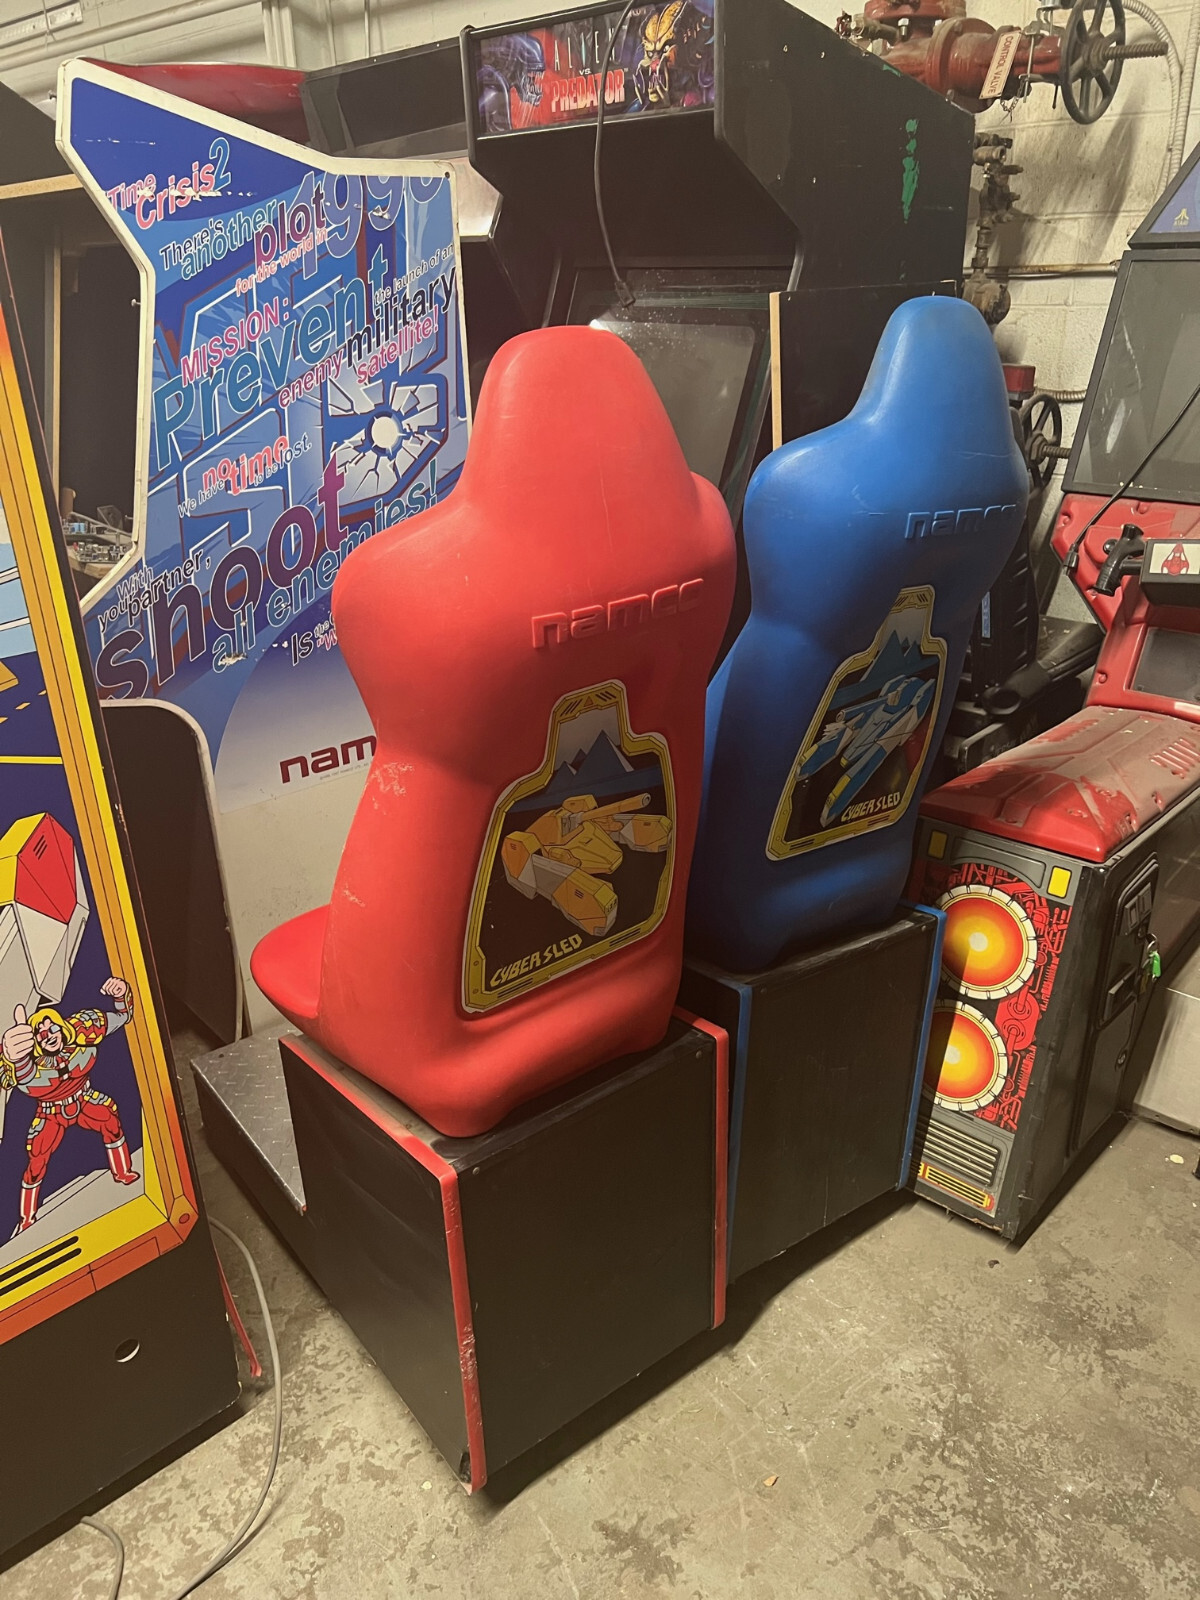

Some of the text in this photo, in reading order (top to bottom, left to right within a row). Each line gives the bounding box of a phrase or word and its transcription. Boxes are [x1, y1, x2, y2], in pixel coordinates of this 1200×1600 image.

[554, 28, 615, 72] ALIEN
[988, 36, 1014, 94] CONTROL VALVE
[551, 69, 626, 113] PREDATOR
[106, 174, 156, 211] Time
[136, 161, 216, 230] Crisis
[159, 218, 224, 271] There's
[181, 199, 277, 280] another
[254, 181, 327, 272] plot
[236, 227, 329, 297] for the world in
[374, 286, 392, 306] the
[393, 260, 429, 293] launch
[429, 248, 441, 268] of
[181, 296, 289, 387] MISSION:
[347, 266, 456, 369] military
[357, 303, 438, 384] satellite!
[152, 243, 389, 471] Prevent
[279, 350, 344, 408] enemy
[202, 435, 289, 496] no time
[265, 462, 279, 479] be
[280, 432, 312, 469] lost.
[178, 479, 225, 518] We have
[116, 564, 153, 602] With
[127, 549, 211, 628] partner,
[212, 602, 256, 673] all
[531, 578, 704, 648] namco
[291, 632, 314, 666] Is
[280, 735, 377, 784] nam
[841, 791, 900, 822] CYBER SLED
[489, 933, 583, 988] CYBER SLED
